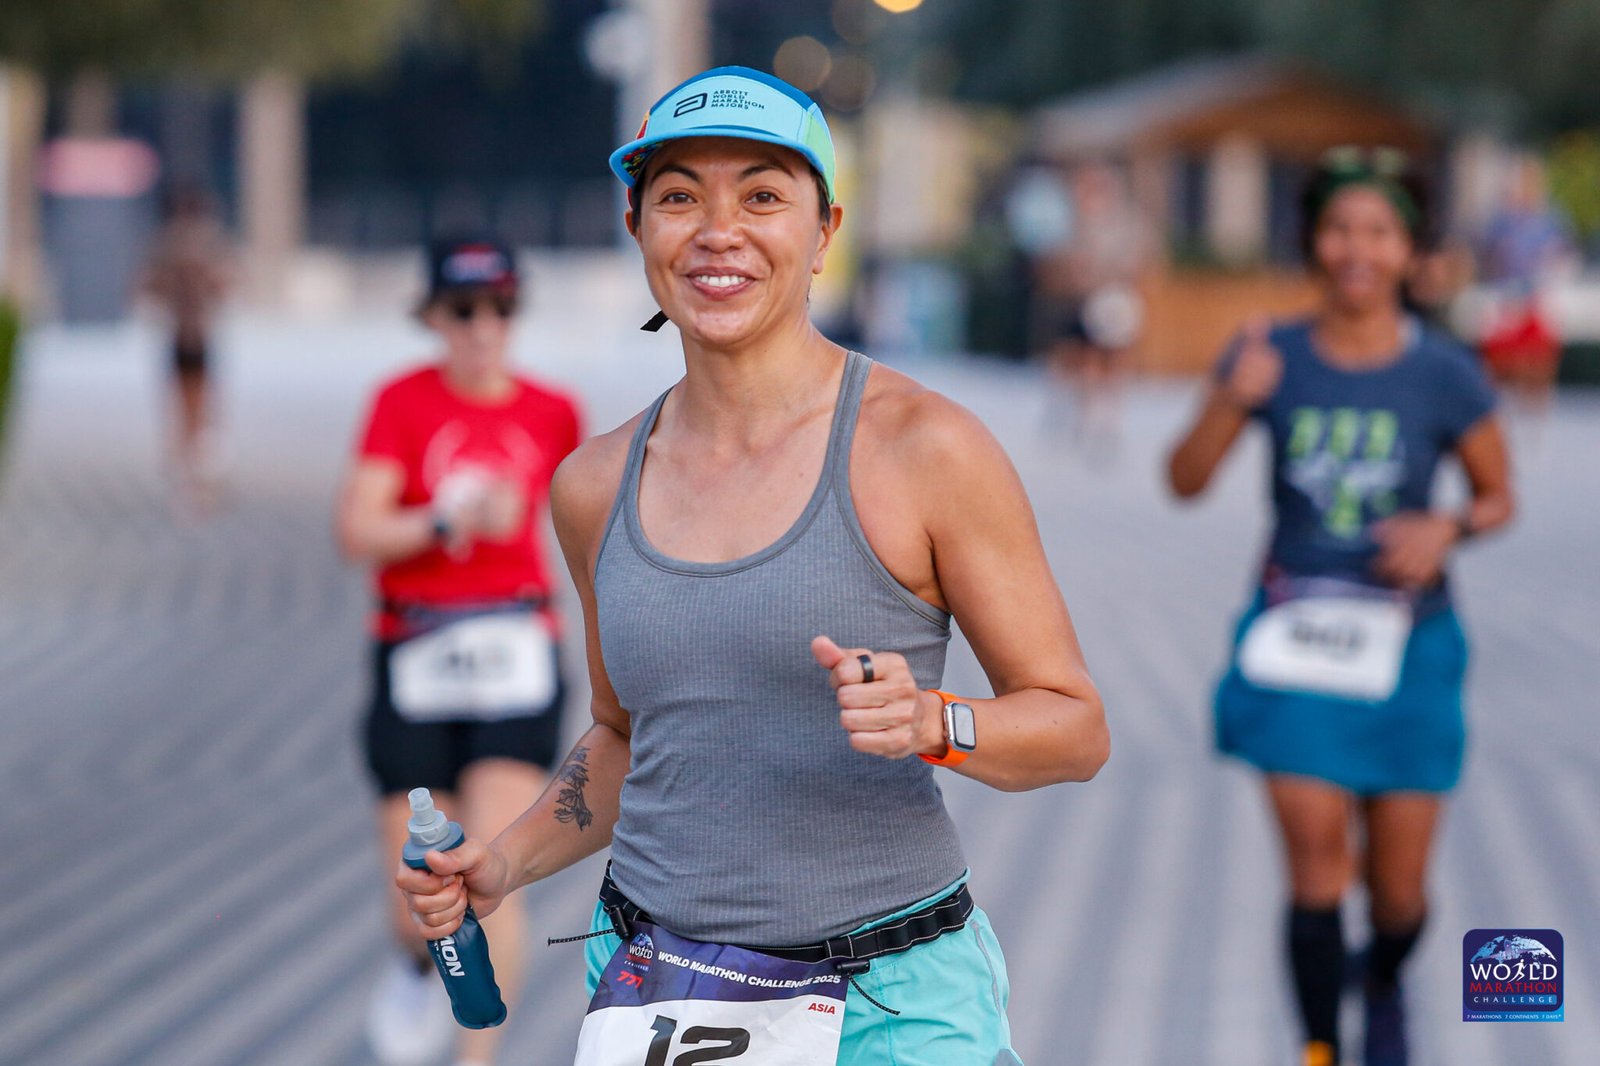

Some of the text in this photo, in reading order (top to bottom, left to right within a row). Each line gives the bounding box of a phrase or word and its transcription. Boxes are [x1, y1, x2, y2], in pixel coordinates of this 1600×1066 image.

[712, 98, 765, 109] MARATHON
[658, 952, 690, 967] WORLD
[690, 962, 747, 983] MARATHON
[748, 977, 812, 988] CHALLENGE
[812, 974, 842, 984] 2025
[807, 1002, 837, 1015] ASIA
[644, 1015, 751, 1066] 12
